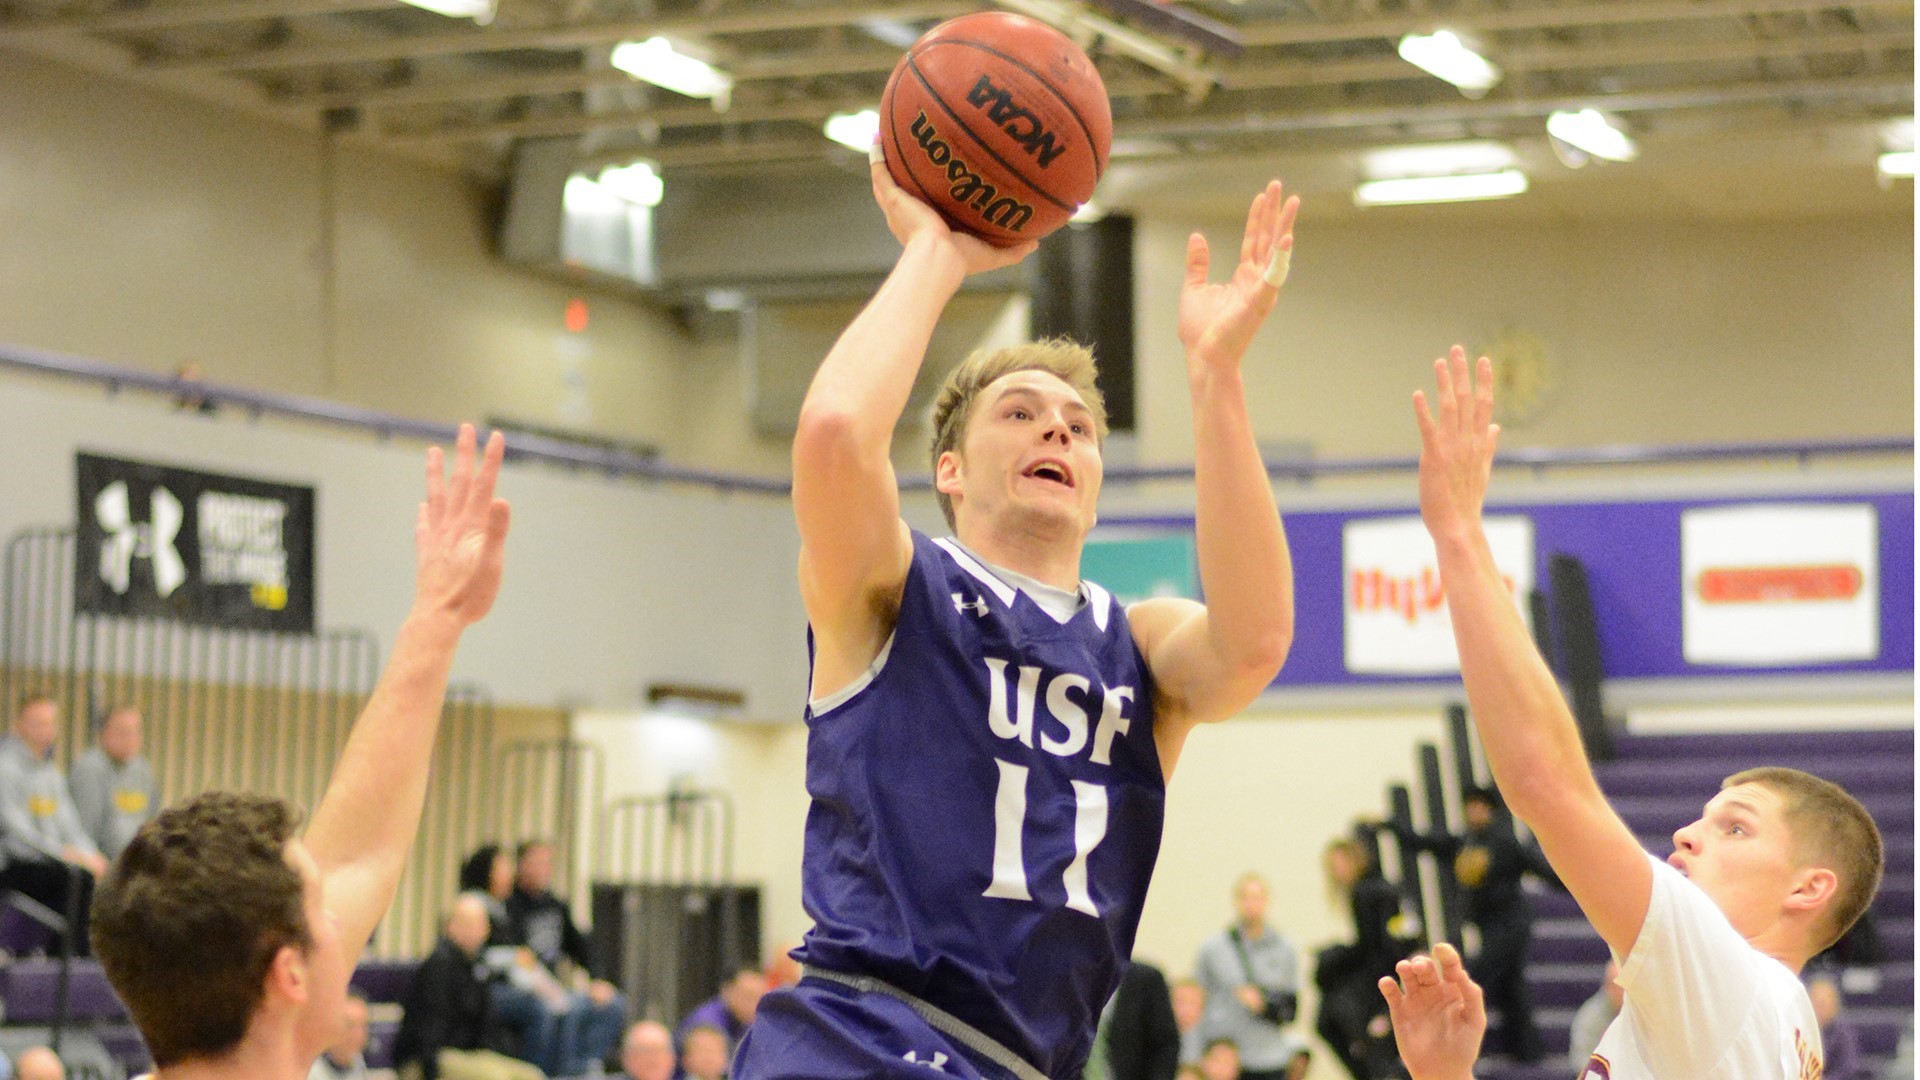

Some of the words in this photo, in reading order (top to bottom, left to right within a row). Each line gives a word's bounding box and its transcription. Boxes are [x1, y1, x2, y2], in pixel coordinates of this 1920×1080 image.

[909, 108, 1036, 233] Wilson
[967, 74, 1066, 169] NCAA
[983, 656, 1135, 766] USF
[981, 757, 1109, 918] 11
